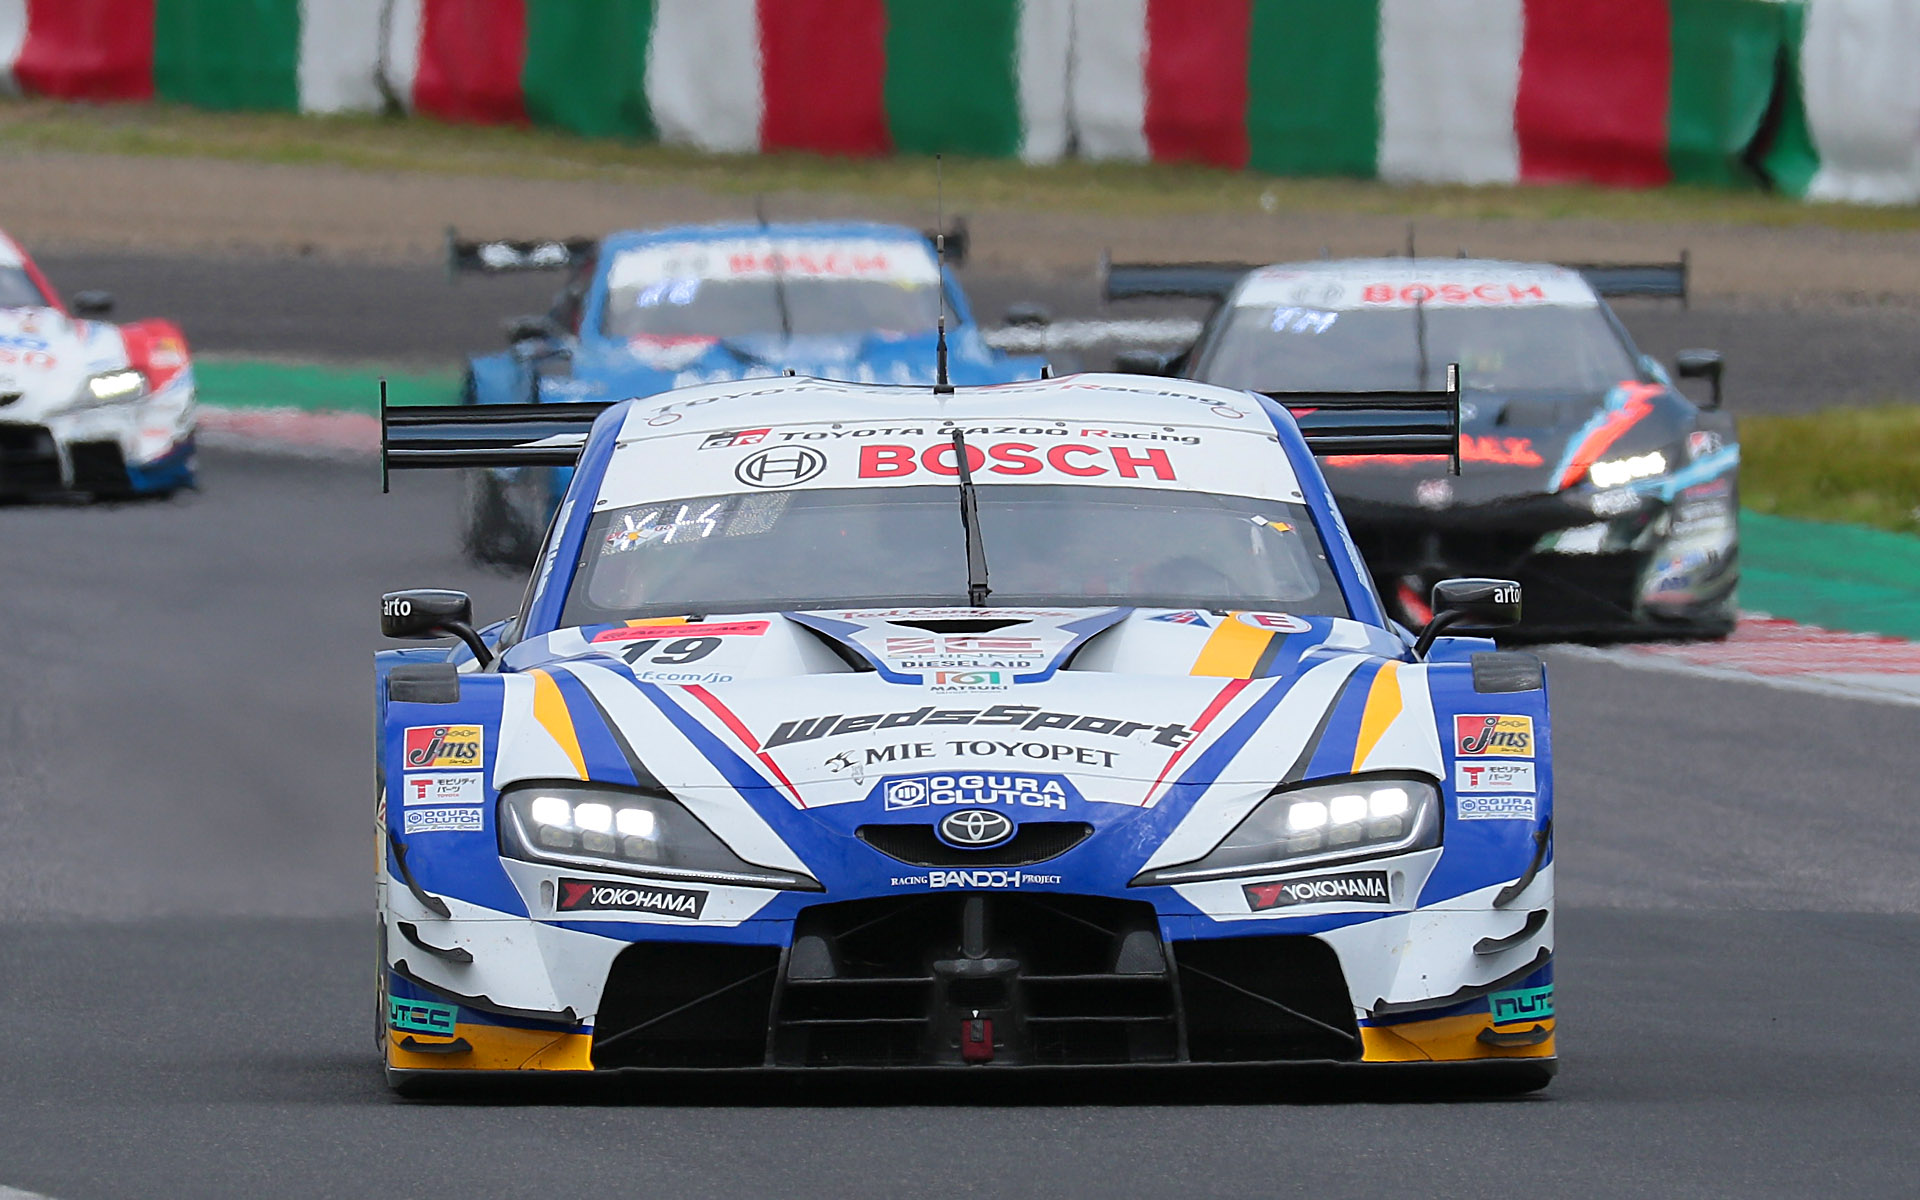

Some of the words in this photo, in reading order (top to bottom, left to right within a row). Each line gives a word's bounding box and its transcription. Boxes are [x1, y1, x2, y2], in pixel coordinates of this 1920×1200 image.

[1363, 283, 1545, 303] BOSCH
[779, 428, 925, 441] TOYOTA
[936, 427, 1069, 437] GAZOO
[1080, 429, 1201, 446] Racing
[858, 443, 1177, 481] BOSCH
[620, 636, 723, 666] 19
[762, 706, 1193, 748] WedsSport
[864, 742, 937, 766] MIE
[945, 740, 1121, 769] TOYOPET
[437, 778, 477, 786] モビリティ
[930, 776, 1066, 796] OGURA
[930, 789, 1067, 811] CLUTCH
[1478, 804, 1533, 812] CLUTCH
[424, 816, 480, 824] CLUTCH
[891, 875, 928, 886] RACING
[928, 870, 1021, 889] BANDOH
[1022, 874, 1061, 884] PROJECT
[1282, 877, 1387, 900] YOKOHAMA
[590, 886, 696, 914] YOKOHAMA
